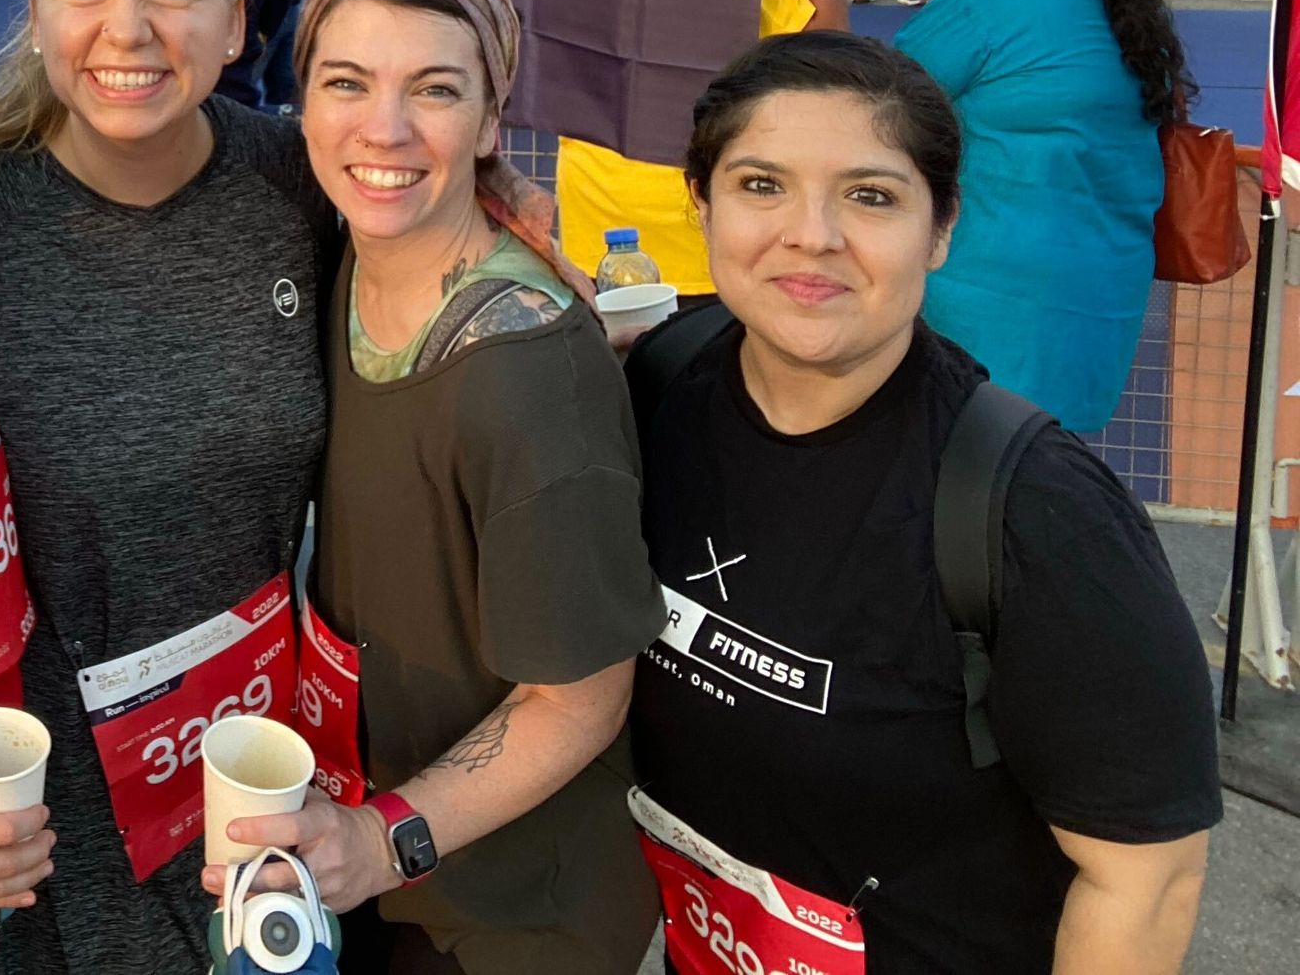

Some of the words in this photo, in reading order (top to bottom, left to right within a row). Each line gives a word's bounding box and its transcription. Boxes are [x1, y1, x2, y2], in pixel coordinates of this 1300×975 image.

[251, 592, 281, 620] 2022
[253, 638, 286, 672] 10KM
[316, 633, 345, 665] 2022
[709, 631, 806, 690] FITNESS
[311, 672, 344, 710] 10KM
[691, 672, 736, 707] Oman
[104, 705, 125, 718] Run
[796, 905, 844, 936] 2022
